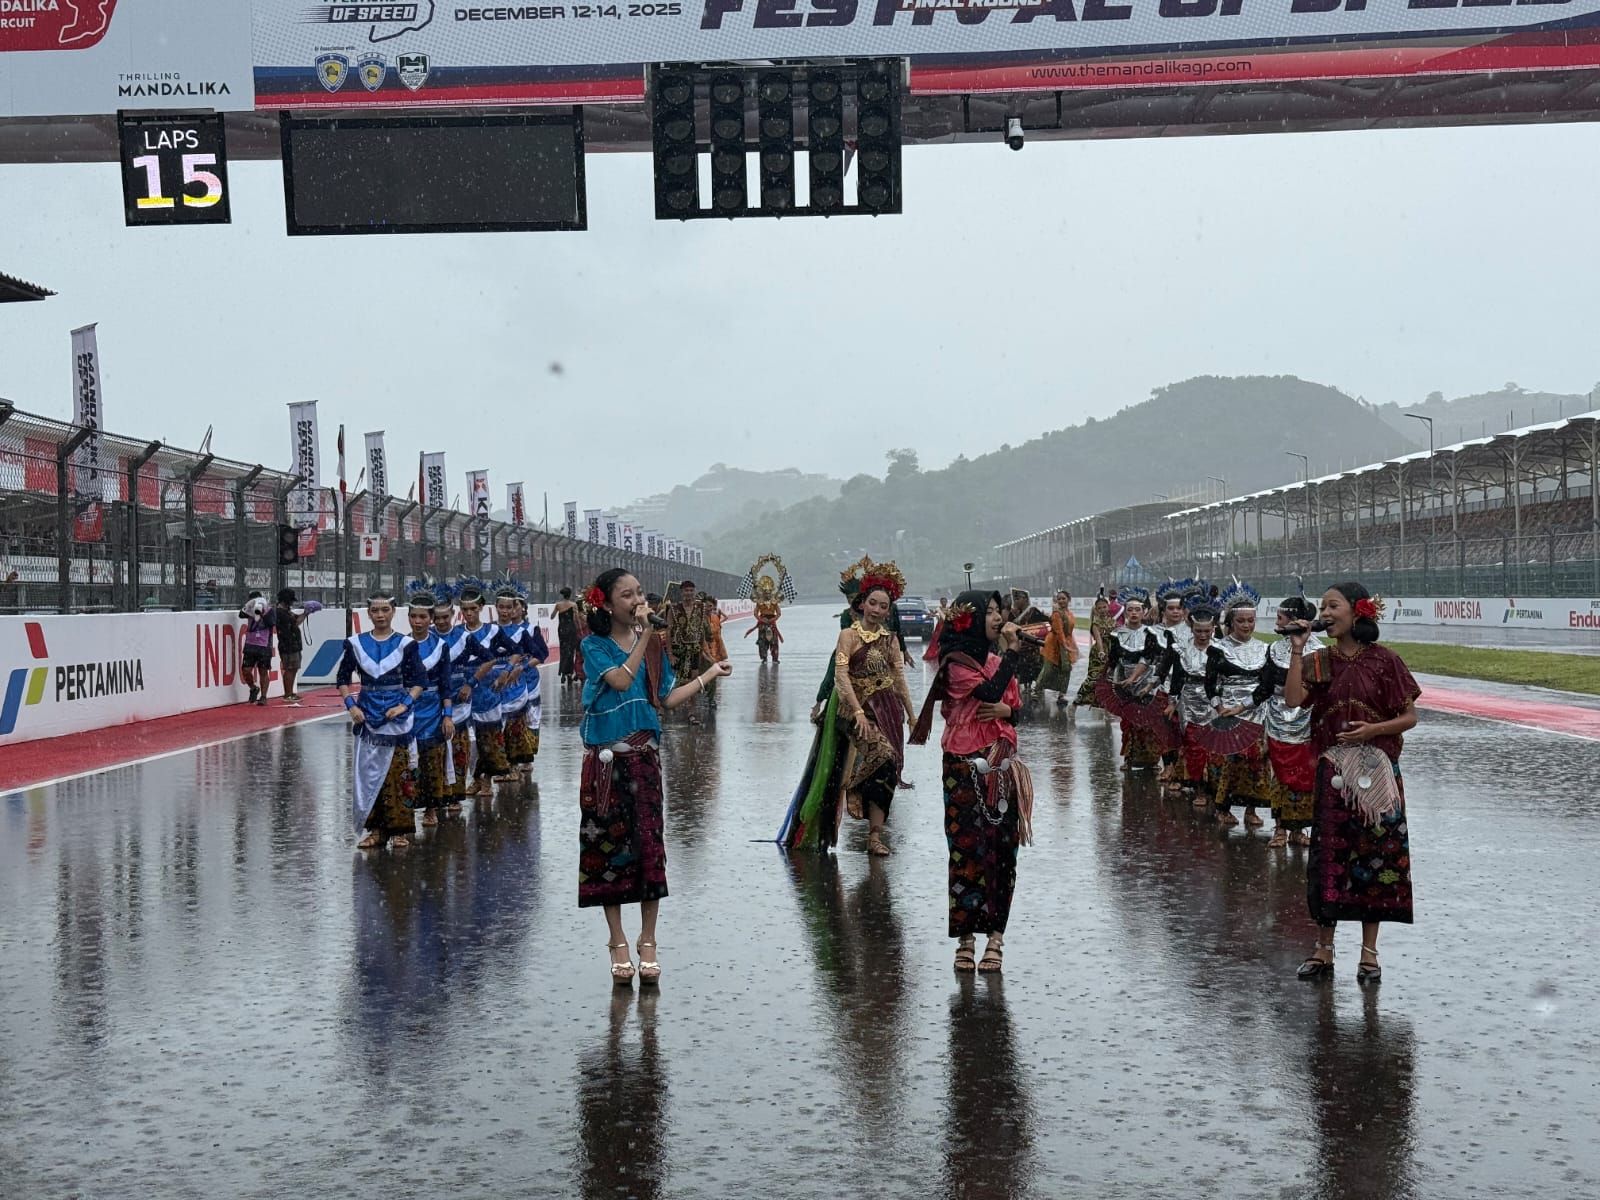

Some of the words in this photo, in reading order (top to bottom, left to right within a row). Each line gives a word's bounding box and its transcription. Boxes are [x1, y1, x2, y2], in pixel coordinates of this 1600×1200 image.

[332, 7, 356, 20] OF
[358, 6, 414, 20] SPEED
[454, 6, 565, 21] DECEMBER
[571, 5, 621, 19] 12-14,
[628, 3, 682, 16] 2025
[1, 18, 36, 28] RCUIT
[118, 72, 180, 81] THRILLING
[1031, 60, 1252, 78] www.themandalikagp.com
[118, 81, 231, 97] MANDALIKA
[144, 129, 199, 149] LAPS
[133, 153, 222, 209] 15
[1434, 601, 1482, 619] INDONESIA
[1516, 609, 1543, 619] PERTAMINA
[56, 658, 144, 702] PERTAMINA
